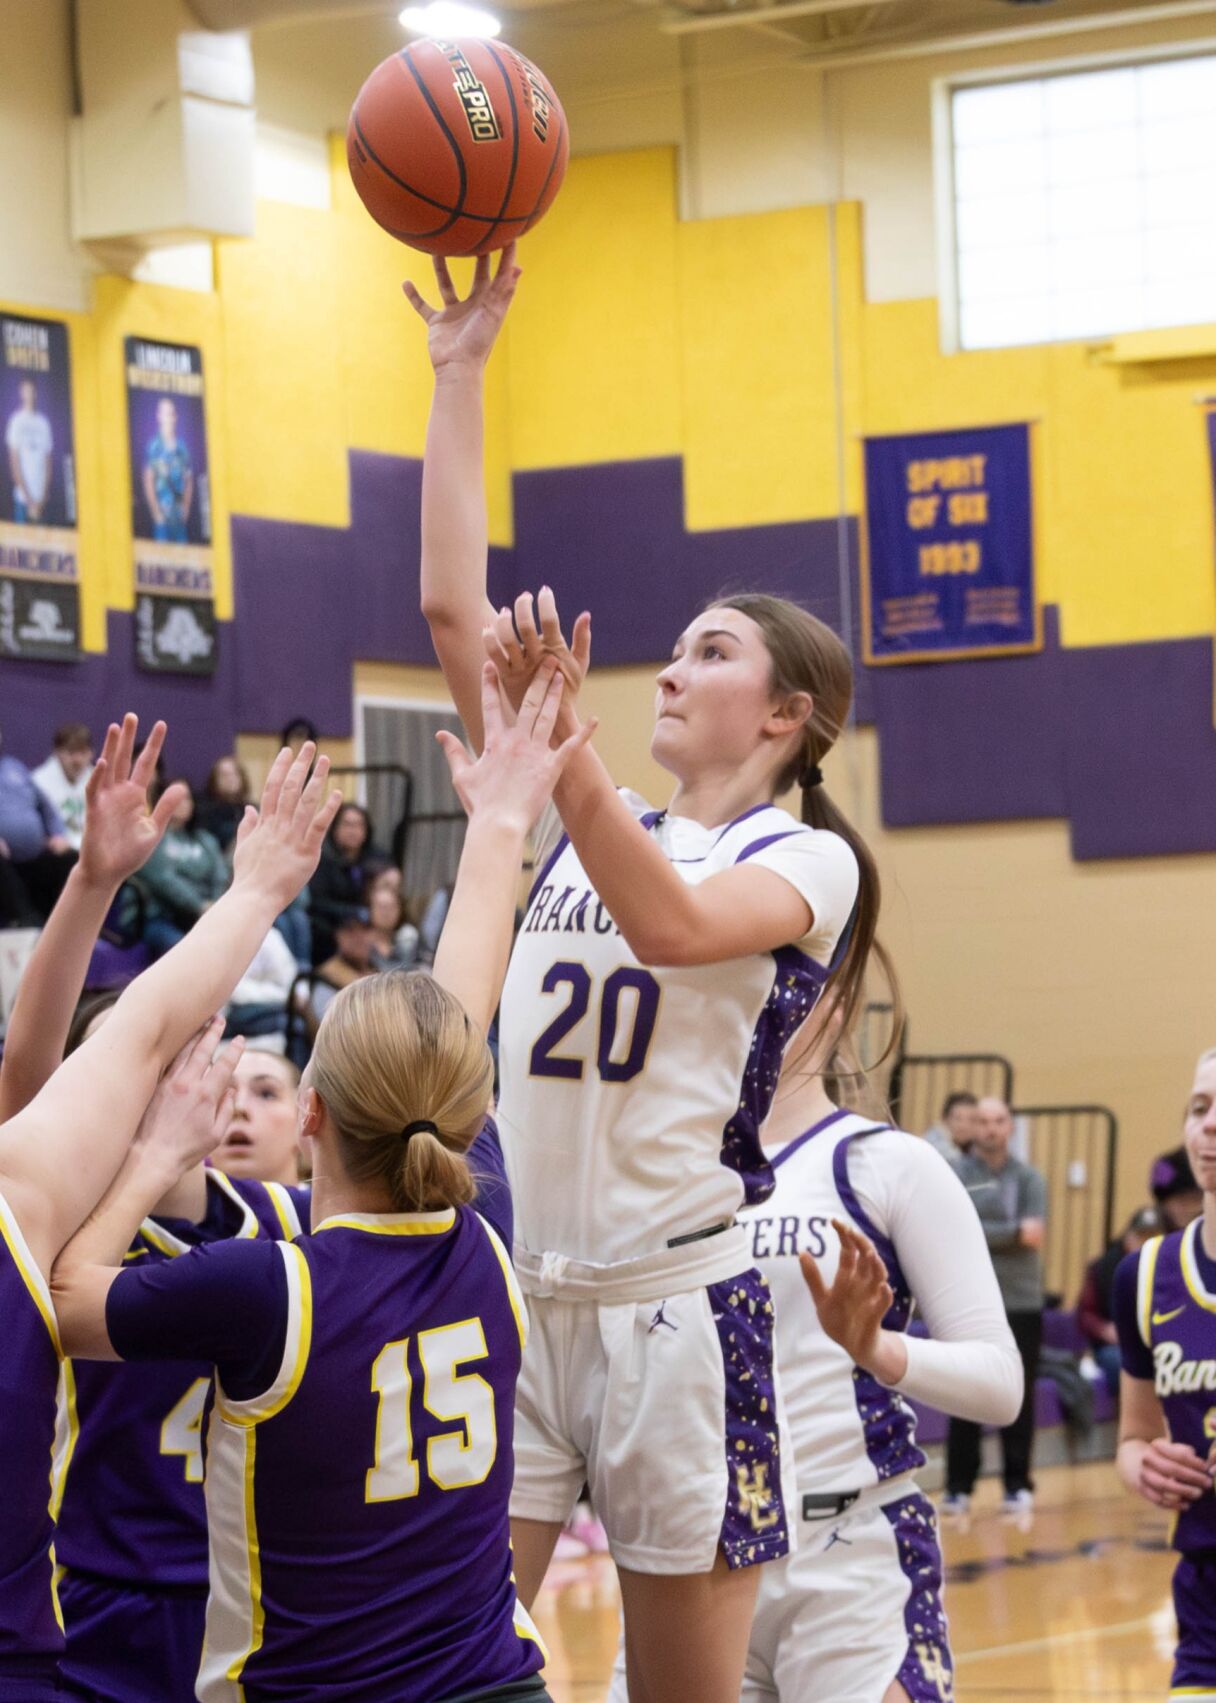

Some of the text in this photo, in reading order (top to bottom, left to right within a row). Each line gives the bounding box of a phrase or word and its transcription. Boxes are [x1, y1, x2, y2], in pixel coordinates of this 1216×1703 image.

[459, 85, 500, 141] PRO
[907, 454, 986, 493] SPIRIT
[907, 491, 988, 530] OF SIX
[525, 885, 621, 936] RANC
[527, 959, 662, 1084] 20
[736, 1215, 828, 1259] ERS
[159, 1376, 213, 1483] 4
[364, 1316, 498, 1505] 15
